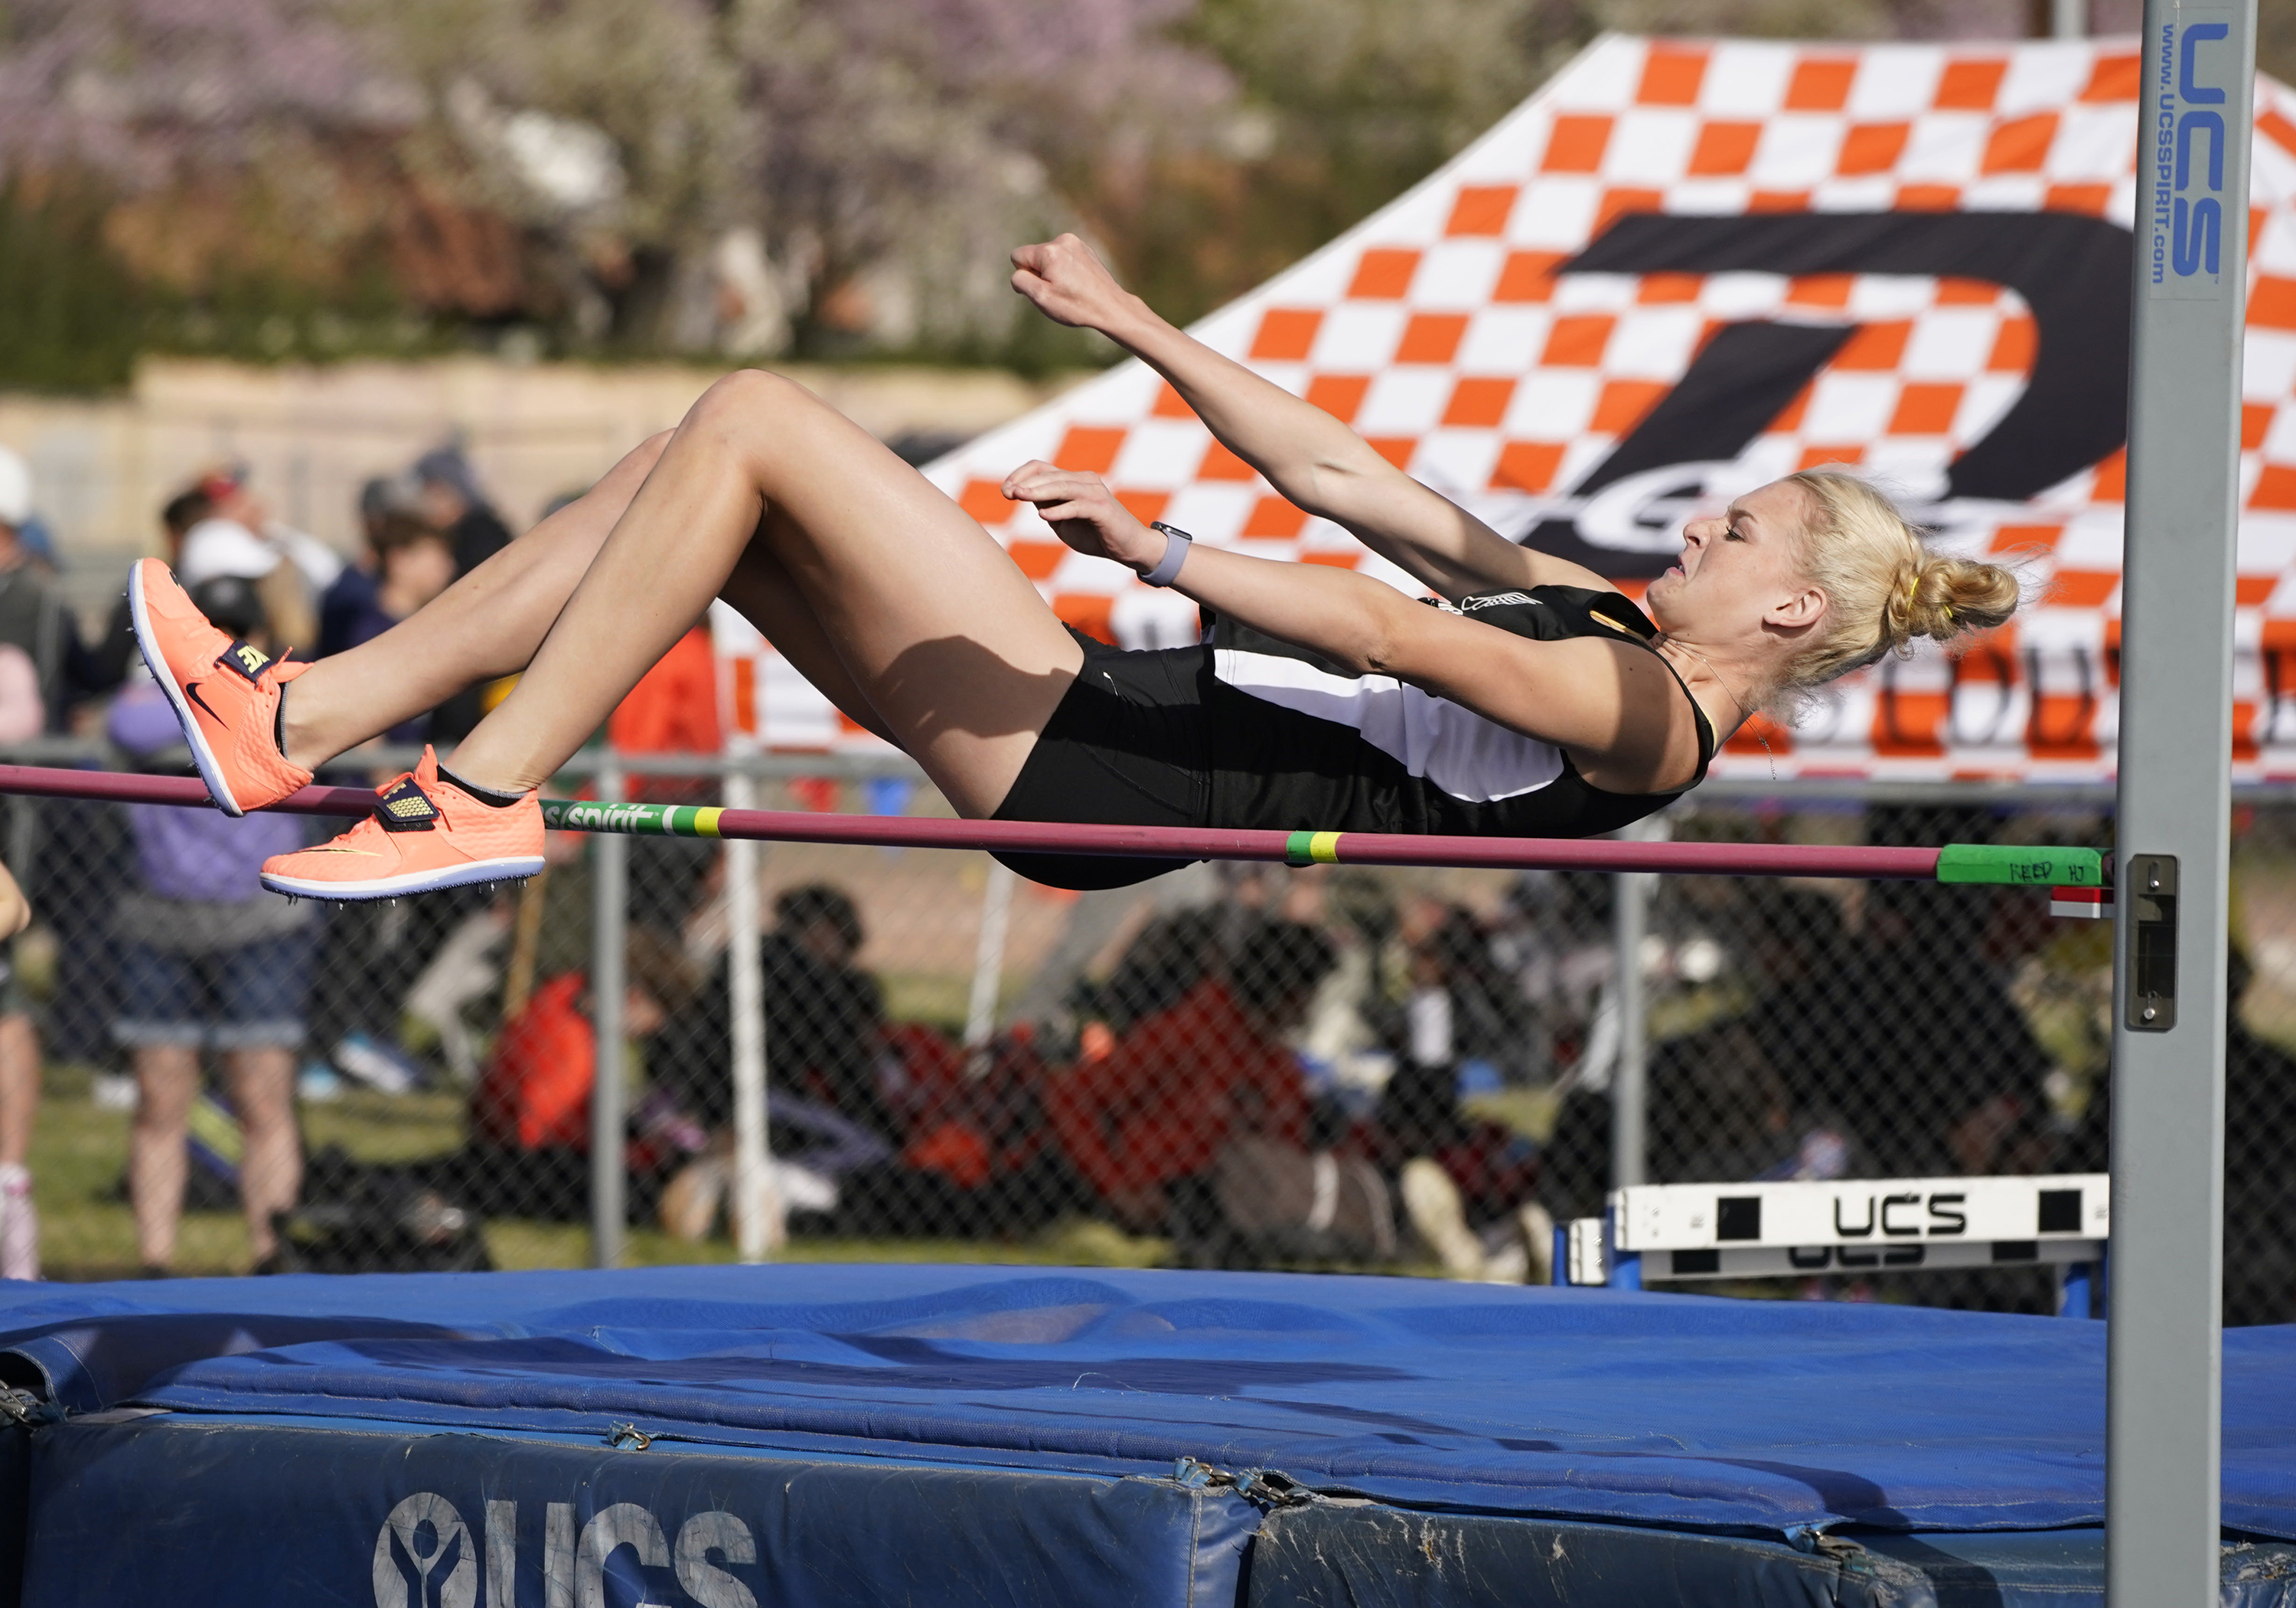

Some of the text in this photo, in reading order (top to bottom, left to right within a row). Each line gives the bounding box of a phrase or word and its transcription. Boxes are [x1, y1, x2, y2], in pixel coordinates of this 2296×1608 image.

[2152, 24, 2175, 284] www.UCSSPIRIT.com
[2172, 23, 2229, 276] UCS
[1834, 1193, 1967, 1238] UCS
